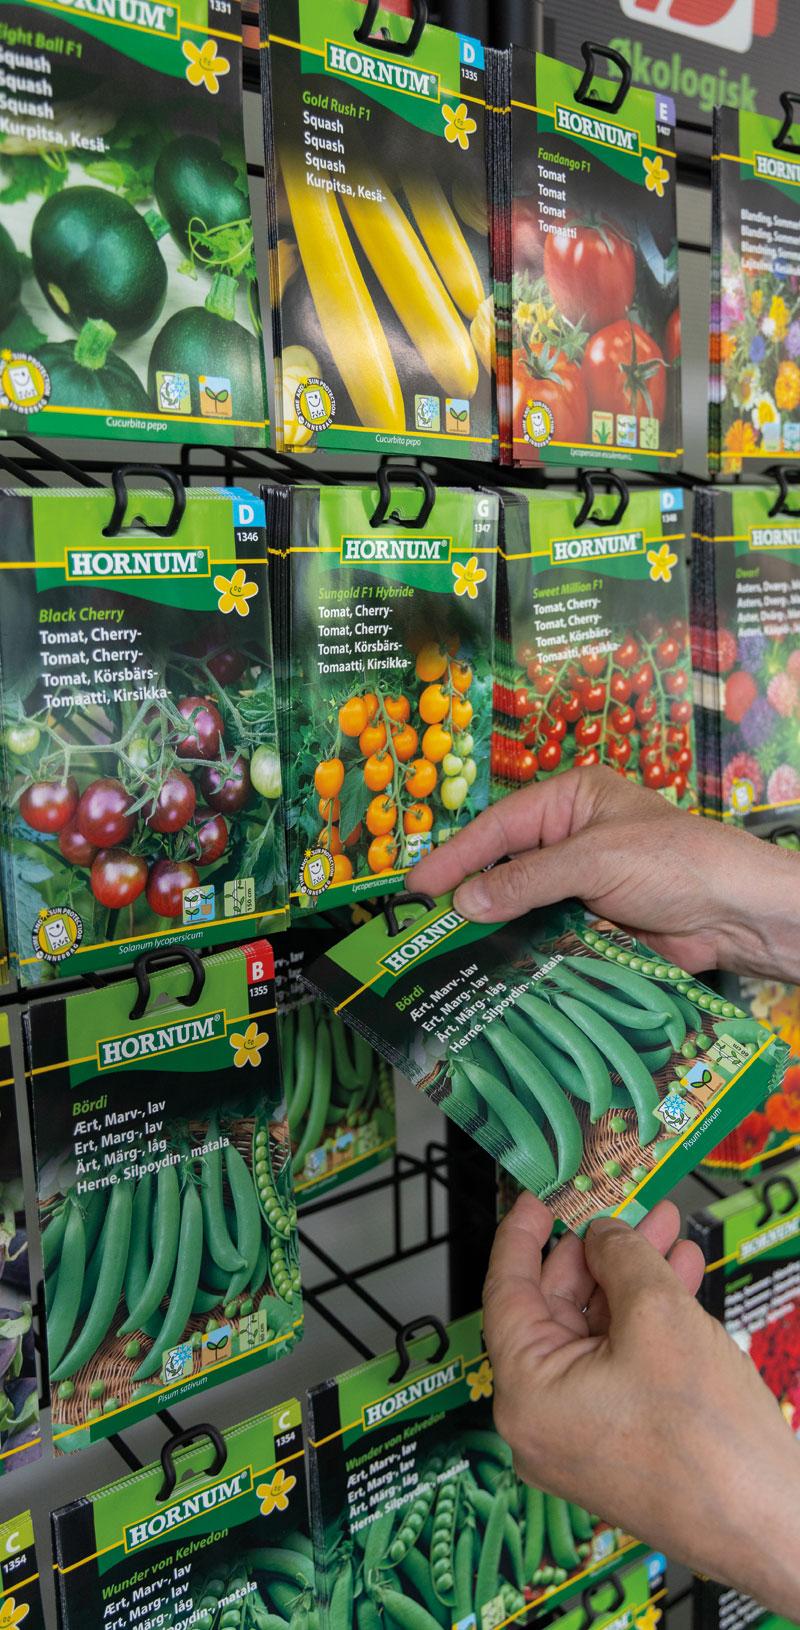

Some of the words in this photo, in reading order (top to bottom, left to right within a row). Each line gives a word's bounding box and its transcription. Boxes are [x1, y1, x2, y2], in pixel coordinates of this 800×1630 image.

[463, 42, 476, 62] D
[302, 90, 329, 111] Gold
[331, 98, 357, 118] Rush
[359, 108, 371, 122] F1
[659, 102, 668, 121] E
[0, 116, 68, 147] Kurpitsa,
[70, 131, 110, 151] Kesä-
[303, 111, 344, 135] Squash
[304, 132, 345, 154] Squash
[305, 153, 346, 175] Squash
[537, 148, 581, 172] Fandango
[581, 158, 591, 173] F1
[538, 165, 566, 184] Tomat
[306, 172, 356, 197] Kurpitsa,
[358, 184, 386, 203] Kesä-
[538, 183, 566, 202] Tomat
[538, 202, 566, 220] Tomat
[538, 219, 577, 239] Tomaatti
[106, 416, 146, 431] Cucurbita
[147, 420, 168, 432] pepo
[375, 433, 404, 445] Cucurbita
[405, 437, 421, 448] pepo
[477, 499, 489, 517] G
[663, 491, 674, 509] D
[239, 504, 254, 525] D
[237, 531, 259, 542] 1346
[318, 587, 360, 602] Sungold
[361, 586, 373, 599] F1
[375, 585, 415, 600] Hybride
[533, 585, 561, 599] Sweet
[561, 581, 591, 596] Million
[39, 609, 76, 624] Black
[79, 608, 125, 624] Cherry
[318, 606, 353, 619] Tomat,
[355, 604, 393, 618] Cherry-
[534, 603, 565, 616] Tomat,
[567, 597, 601, 612] Cherry-
[318, 625, 353, 638] Tomat,
[354, 623, 393, 636] Cherry-
[535, 619, 566, 632] Tomat,
[568, 614, 602, 628] Cherry-
[40, 630, 88, 646] Tomat,
[91, 627, 142, 643] Cherry-
[536, 635, 568, 649] Tomat,
[569, 629, 612, 643] Körsbärs-
[41, 651, 90, 667] Tomat,
[92, 648, 143, 664] Cherry-
[318, 643, 352, 657] Tomat,
[354, 640, 403, 653] Körsbärs-
[537, 648, 582, 664] Tomaatti,
[318, 662, 366, 675] Tomaatti,
[367, 657, 412, 670] Kirsikka-
[42, 672, 91, 689] Tomat,
[94, 668, 158, 684] Körsbärs-
[44, 693, 110, 709] Tomaatti,
[114, 688, 173, 702] Kirsikka-
[49, 907, 62, 915] SUN
[63, 907, 83, 940] PROTECTION
[43, 944, 78, 962] INNERBAG
[118, 940, 153, 956] Solanum
[154, 930, 204, 951] lycopersicum
[252, 961, 264, 981] B
[249, 985, 268, 998] 1355
[395, 985, 425, 1012] Bördi
[409, 995, 435, 1022] Ært,
[430, 974, 463, 1004] Marv-,
[465, 962, 479, 978] lav
[421, 1007, 445, 1032] Ert,
[440, 987, 476, 1017] Marg-,
[475, 974, 490, 989] lav
[434, 1018, 459, 1043] Ärt,
[455, 996, 491, 1026] Märg-,
[490, 981, 507, 1002] låg
[449, 1022, 487, 1054] Herne,
[482, 979, 535, 1023] Silpoydin-,
[531, 953, 565, 981] matala
[72, 1095, 107, 1116] Bördi
[73, 1120, 101, 1136] Ært,
[105, 1108, 145, 1127] Marv-,
[148, 1100, 166, 1114] lav
[682, 1130, 702, 1150] Pisum
[700, 1107, 722, 1132] sativum
[75, 1140, 98, 1155] Ert,
[101, 1129, 143, 1149] Marg-,
[145, 1120, 163, 1134] lav
[76, 1158, 101, 1175] Ärt,
[104, 1148, 145, 1168] Märg-,
[148, 1138, 167, 1154] låg
[77, 1173, 121, 1195] Herne,
[123, 1152, 188, 1181] Silpoydin-,
[191, 1136, 230, 1157] matala
[158, 1389, 179, 1404] Pisum
[180, 1376, 208, 1394] sativum
[278, 1410, 291, 1430] C
[276, 1432, 295, 1448] 1354
[345, 1443, 383, 1472] Wunder
[384, 1433, 402, 1450] von
[347, 1472, 368, 1489] Ært,
[369, 1453, 401, 1476] Marv-,
[402, 1441, 418, 1455] lav
[348, 1487, 366, 1503] Ert,
[367, 1469, 399, 1493] Marg-,
[400, 1458, 415, 1473] lav
[349, 1502, 368, 1519] Ärt,
[369, 1485, 402, 1507] Märg-,
[402, 1472, 419, 1488] låg
[350, 1512, 383, 1534] Herne,
[437, 1459, 470, 1484] matala
[5, 1532, 20, 1553] C
[3, 1554, 27, 1574] 1354
[102, 1566, 150, 1601] Wunder
[151, 1556, 173, 1575] von
[175, 1527, 229, 1562] Kelvedon
[103, 1598, 130, 1618] Ært,
[132, 1577, 171, 1603] Marv-,
[173, 1563, 192, 1578] lav
[217, 1580, 258, 1608] matala
[129, 1596, 169, 1622] Marg-,
[171, 1581, 189, 1597] lav
[174, 1597, 193, 1616] låg
